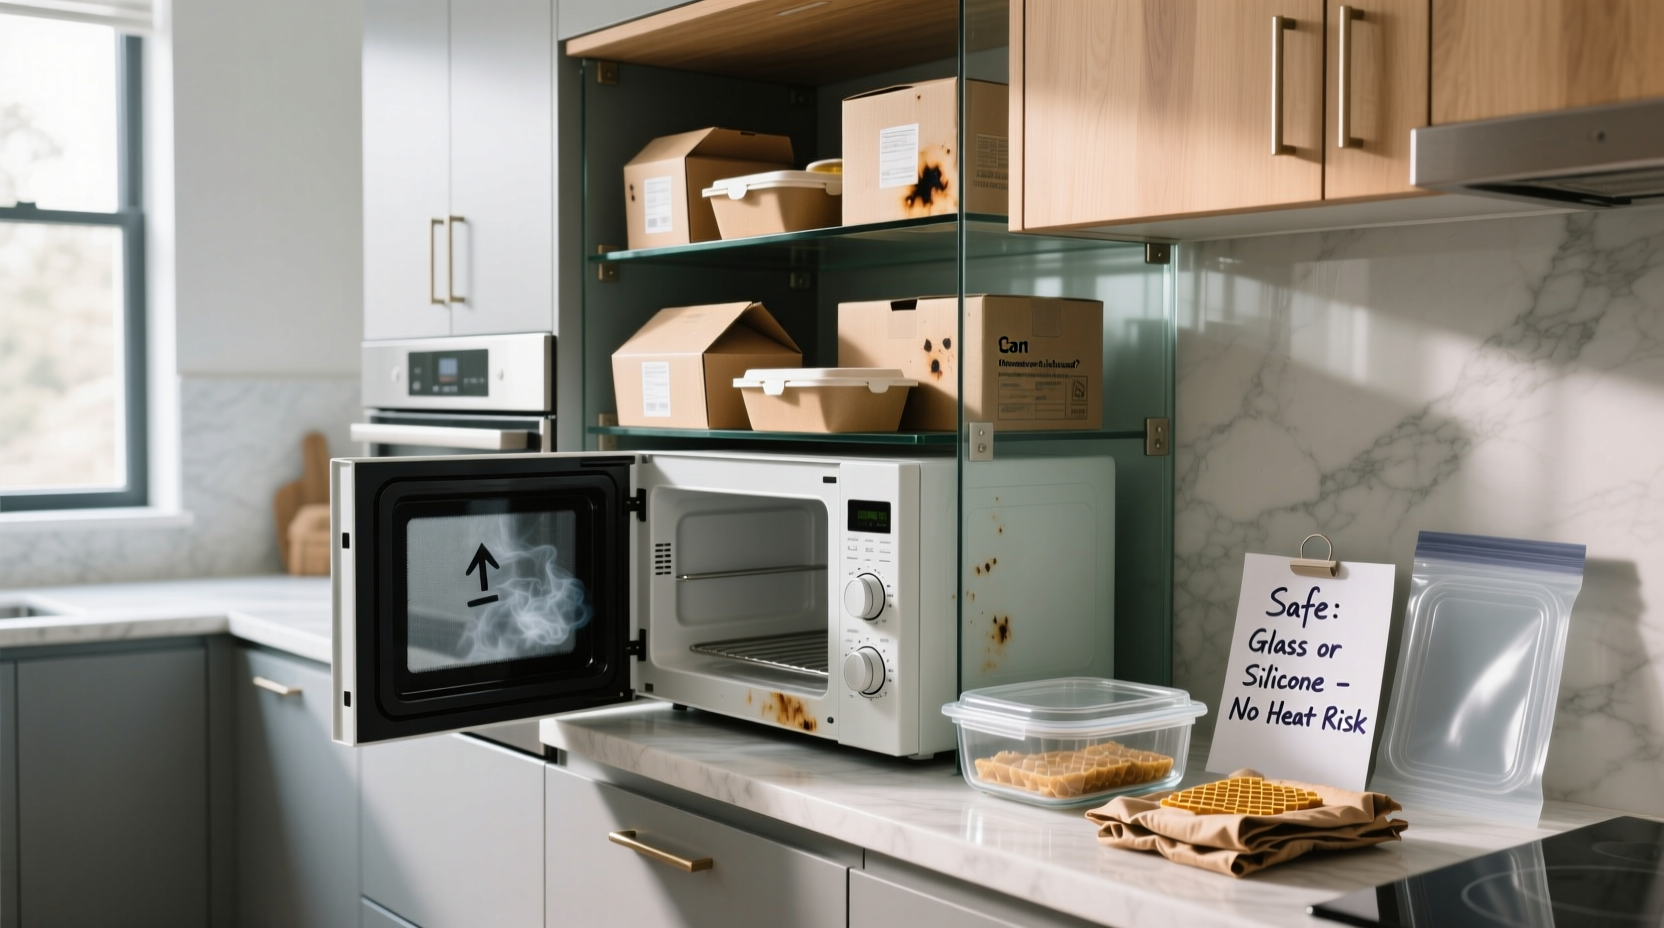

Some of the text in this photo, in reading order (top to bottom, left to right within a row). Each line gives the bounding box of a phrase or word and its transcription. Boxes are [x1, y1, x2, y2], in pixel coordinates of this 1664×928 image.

[998, 336, 1028, 353] Can
[1265, 586, 1340, 628] Safe:
[1248, 627, 1342, 659] Glass or
[1242, 663, 1324, 692] Silicone
[1229, 696, 1368, 734] No Heat Risk
